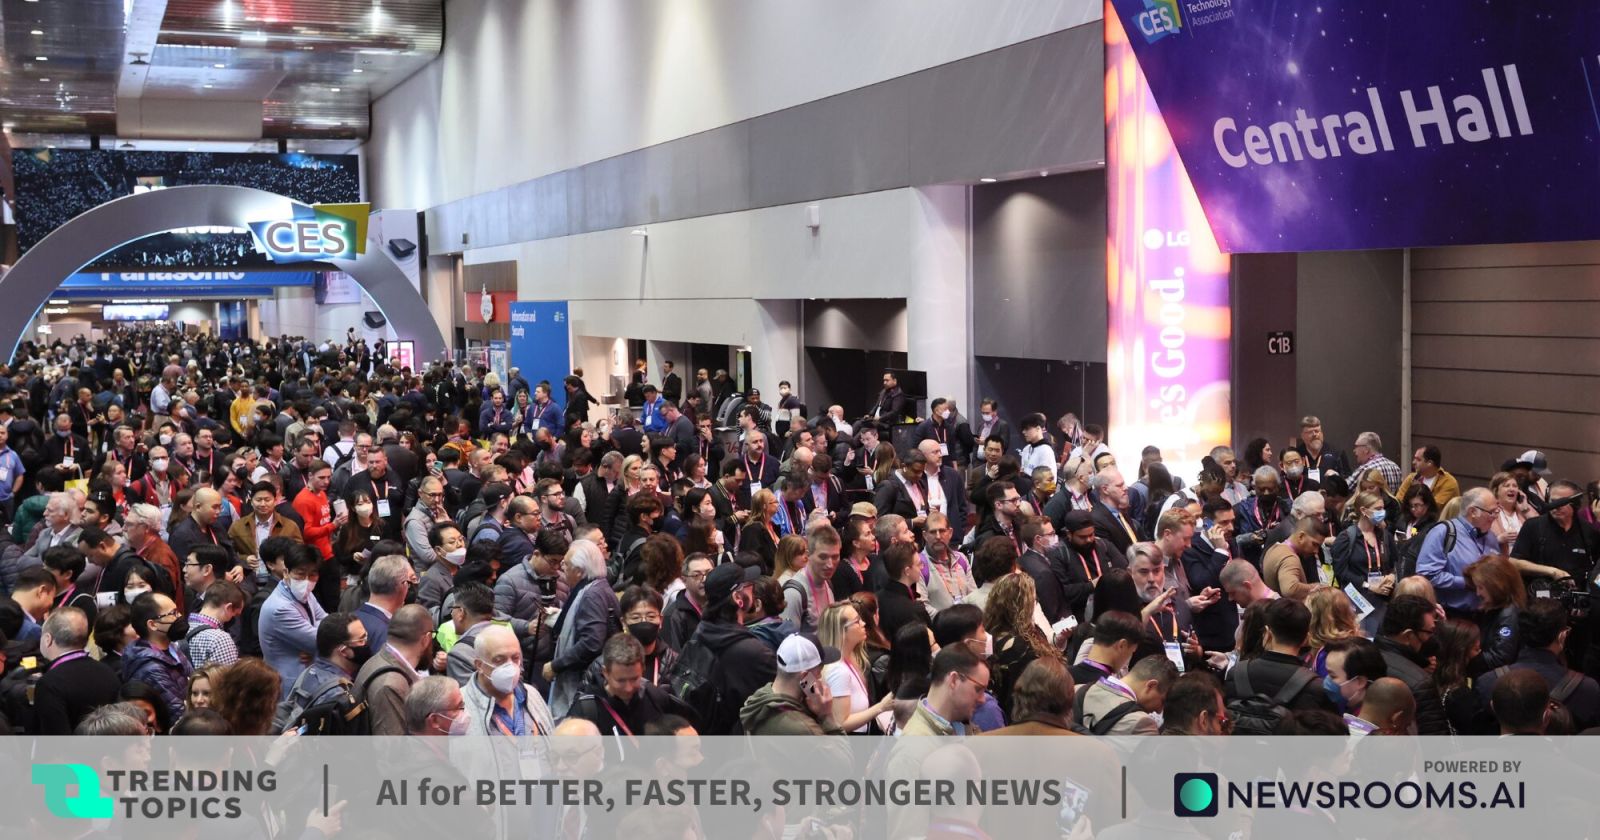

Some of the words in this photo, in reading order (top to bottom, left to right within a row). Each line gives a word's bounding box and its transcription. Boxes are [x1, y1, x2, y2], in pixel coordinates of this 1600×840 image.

[1187, 0, 1232, 13] Technology
[1192, 9, 1235, 27] Association
[1139, 6, 1174, 36] CES
[1213, 87, 1395, 168] Central
[1400, 64, 1534, 148] Hall
[266, 222, 345, 254] CES
[1166, 230, 1191, 247] LG
[1150, 266, 1186, 379] Good.
[1268, 336, 1291, 354] C1B
